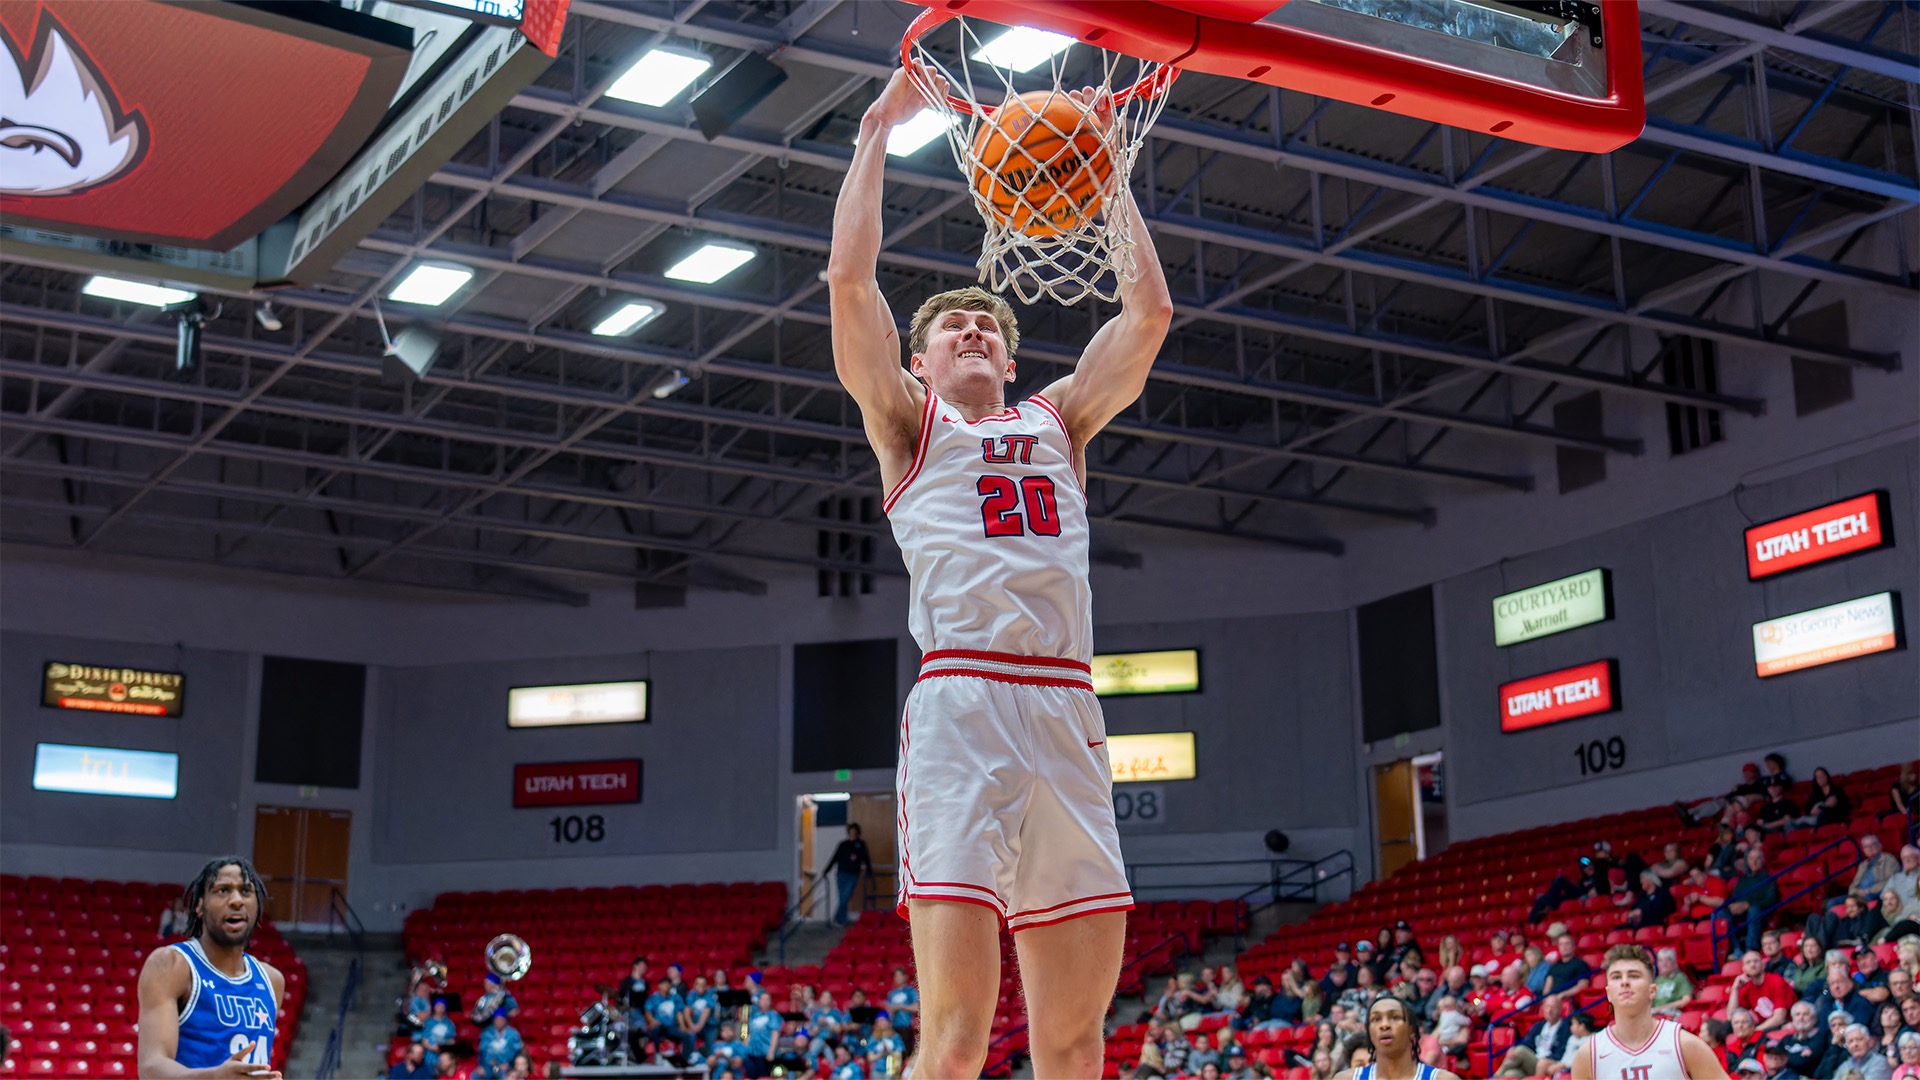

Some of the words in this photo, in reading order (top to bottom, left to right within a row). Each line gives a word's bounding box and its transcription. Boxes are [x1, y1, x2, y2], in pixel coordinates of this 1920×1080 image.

[981, 434, 1039, 465] UT
[976, 475, 1062, 538] 20
[1756, 528, 1810, 562] UTAH
[1811, 512, 1869, 546] TECH
[1497, 578, 1591, 619] COURTYARD
[1520, 608, 1568, 636] Marriott
[1801, 613, 1845, 635] George
[1847, 603, 1885, 622] News
[69, 664, 119, 681] DIXIE
[121, 668, 182, 687] DIRECT
[1508, 688, 1551, 717] UTAH
[1552, 677, 1600, 706] TECH
[81, 752, 128, 785] tru
[1574, 735, 1626, 776] 109
[525, 775, 574, 793] UTAH
[578, 773, 627, 790] TECH
[1114, 791, 1158, 821] 08
[550, 814, 605, 843] 108
[214, 993, 274, 1032] UTA
